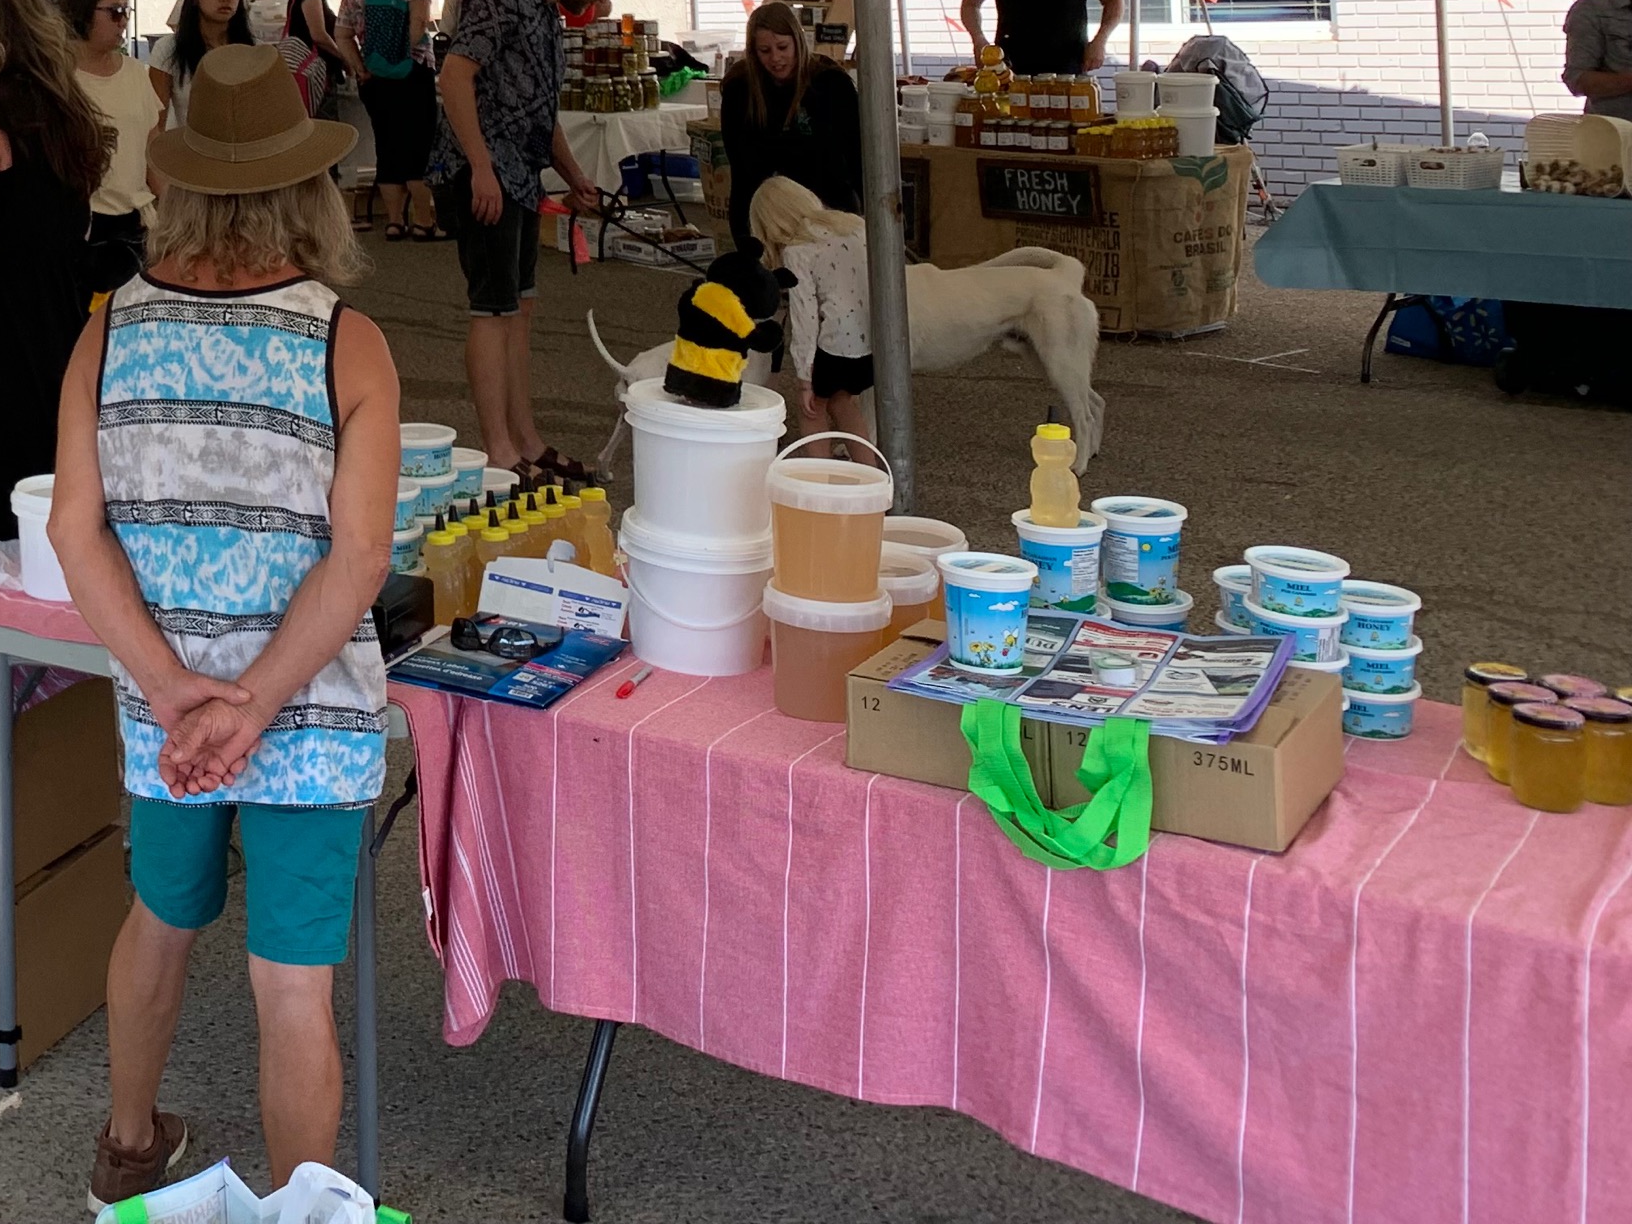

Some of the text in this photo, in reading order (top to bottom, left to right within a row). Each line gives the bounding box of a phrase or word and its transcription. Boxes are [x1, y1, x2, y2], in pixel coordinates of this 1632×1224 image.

[1004, 168, 1068, 191] FRESH
[1016, 189, 1081, 215] HONEY
[1185, 241, 1226, 258] BRASIL
[1286, 582, 1313, 592] MIEL
[1357, 622, 1391, 631] HONEY
[1366, 662, 1391, 670] MIEL
[861, 696, 881, 712] 12
[1067, 731, 1087, 747] 12
[1193, 750, 1255, 777] 375ML
